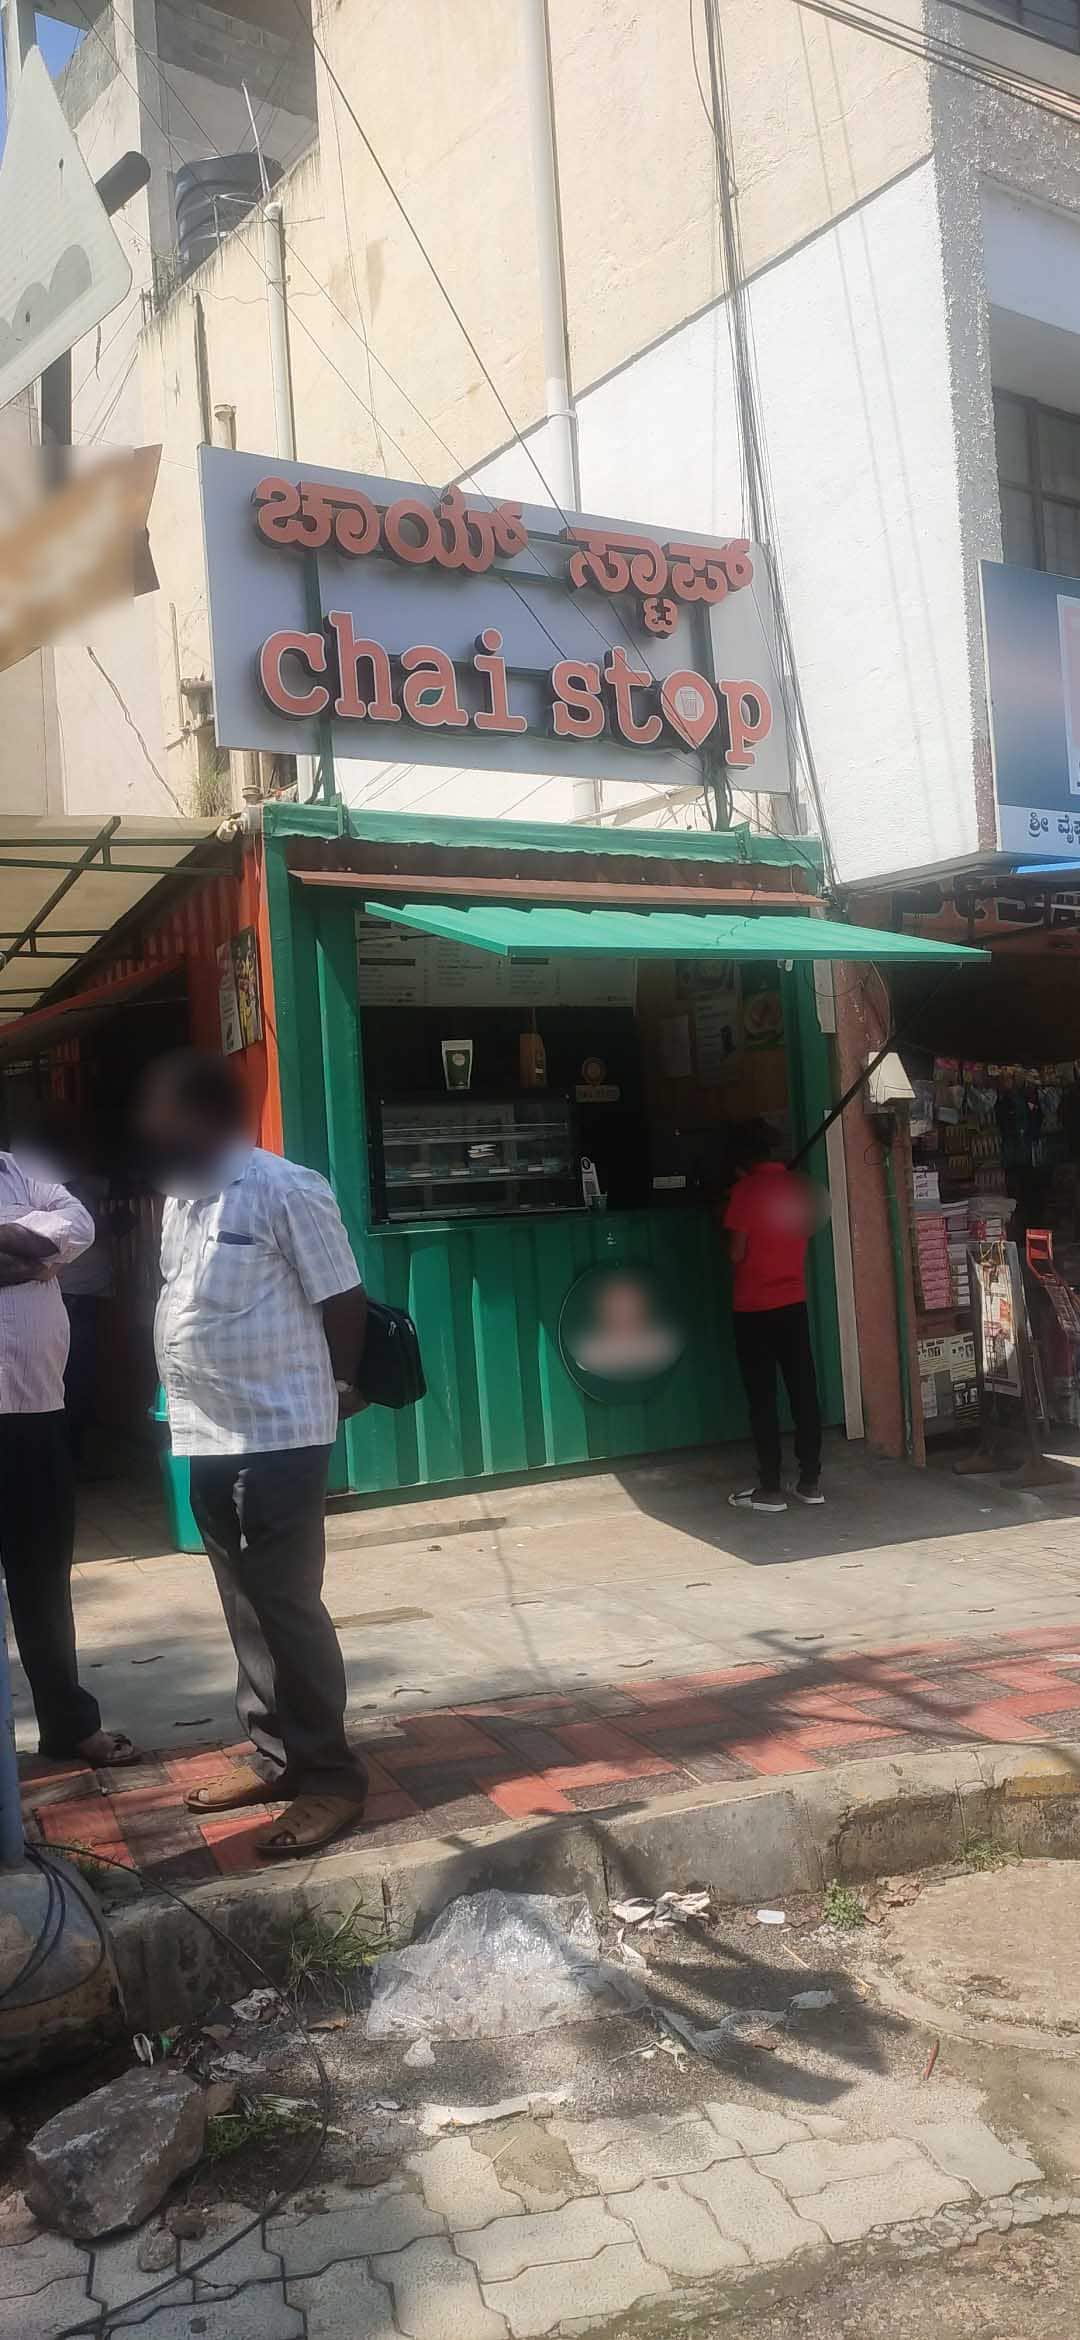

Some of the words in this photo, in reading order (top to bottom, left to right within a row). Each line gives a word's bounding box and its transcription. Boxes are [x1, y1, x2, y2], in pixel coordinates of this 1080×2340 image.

[560, 527, 754, 638] ಸ್ಟಾಪ್
[257, 610, 528, 733] chai
[548, 646, 774, 769] stop
[1028, 811, 1049, 838] ಶ್ರೀ
